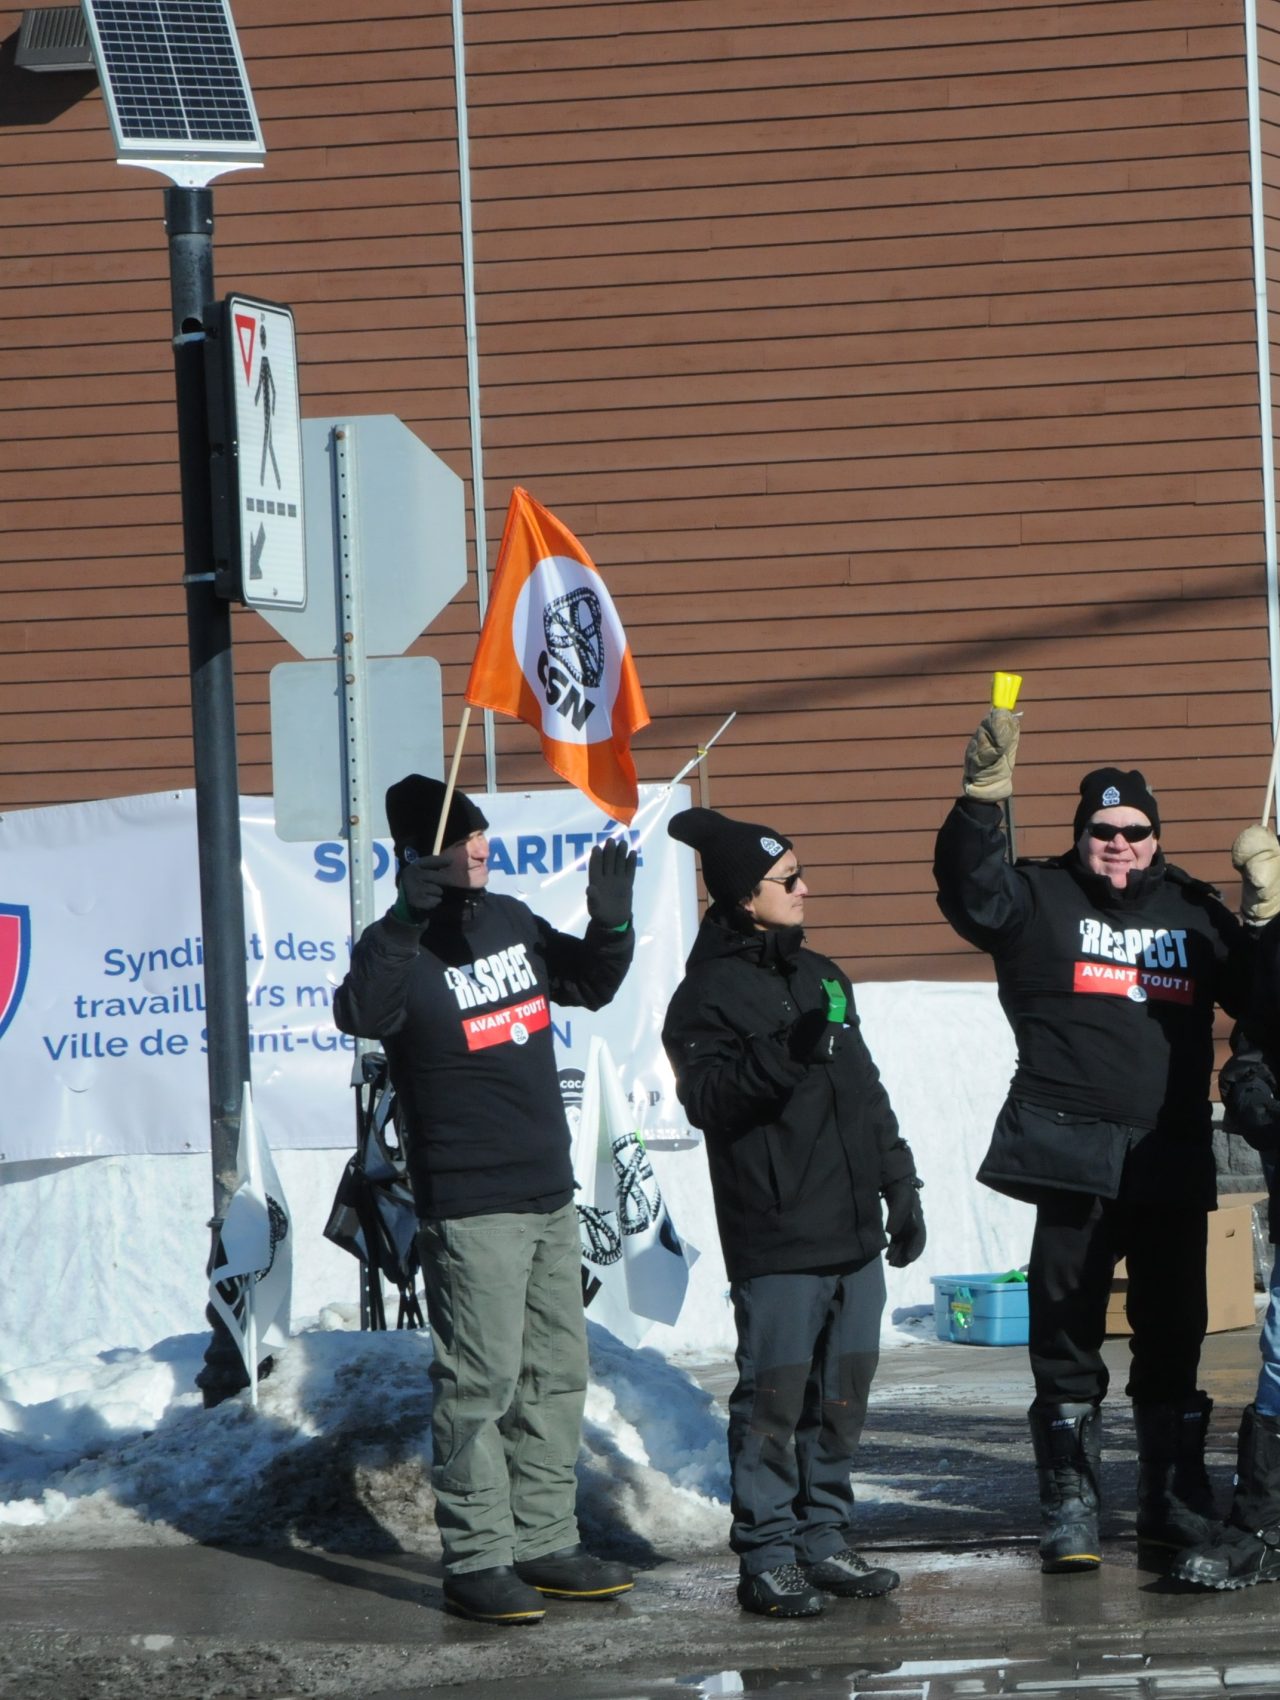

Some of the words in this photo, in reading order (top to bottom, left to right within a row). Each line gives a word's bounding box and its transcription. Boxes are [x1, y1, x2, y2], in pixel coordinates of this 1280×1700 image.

[537, 650, 596, 732] CSN
[314, 819, 643, 884] SARIT!
[104, 933, 264, 982] Syndit
[274, 932, 336, 961] des
[1082, 918, 1188, 968] RESPECT
[447, 943, 537, 1010] RESPECT
[1082, 966, 1137, 983] AVANT
[75, 983, 285, 1019] travaillrs
[469, 1011, 511, 1033] AVANT
[42, 1031, 128, 1061] Ville
[140, 1028, 188, 1056] de
